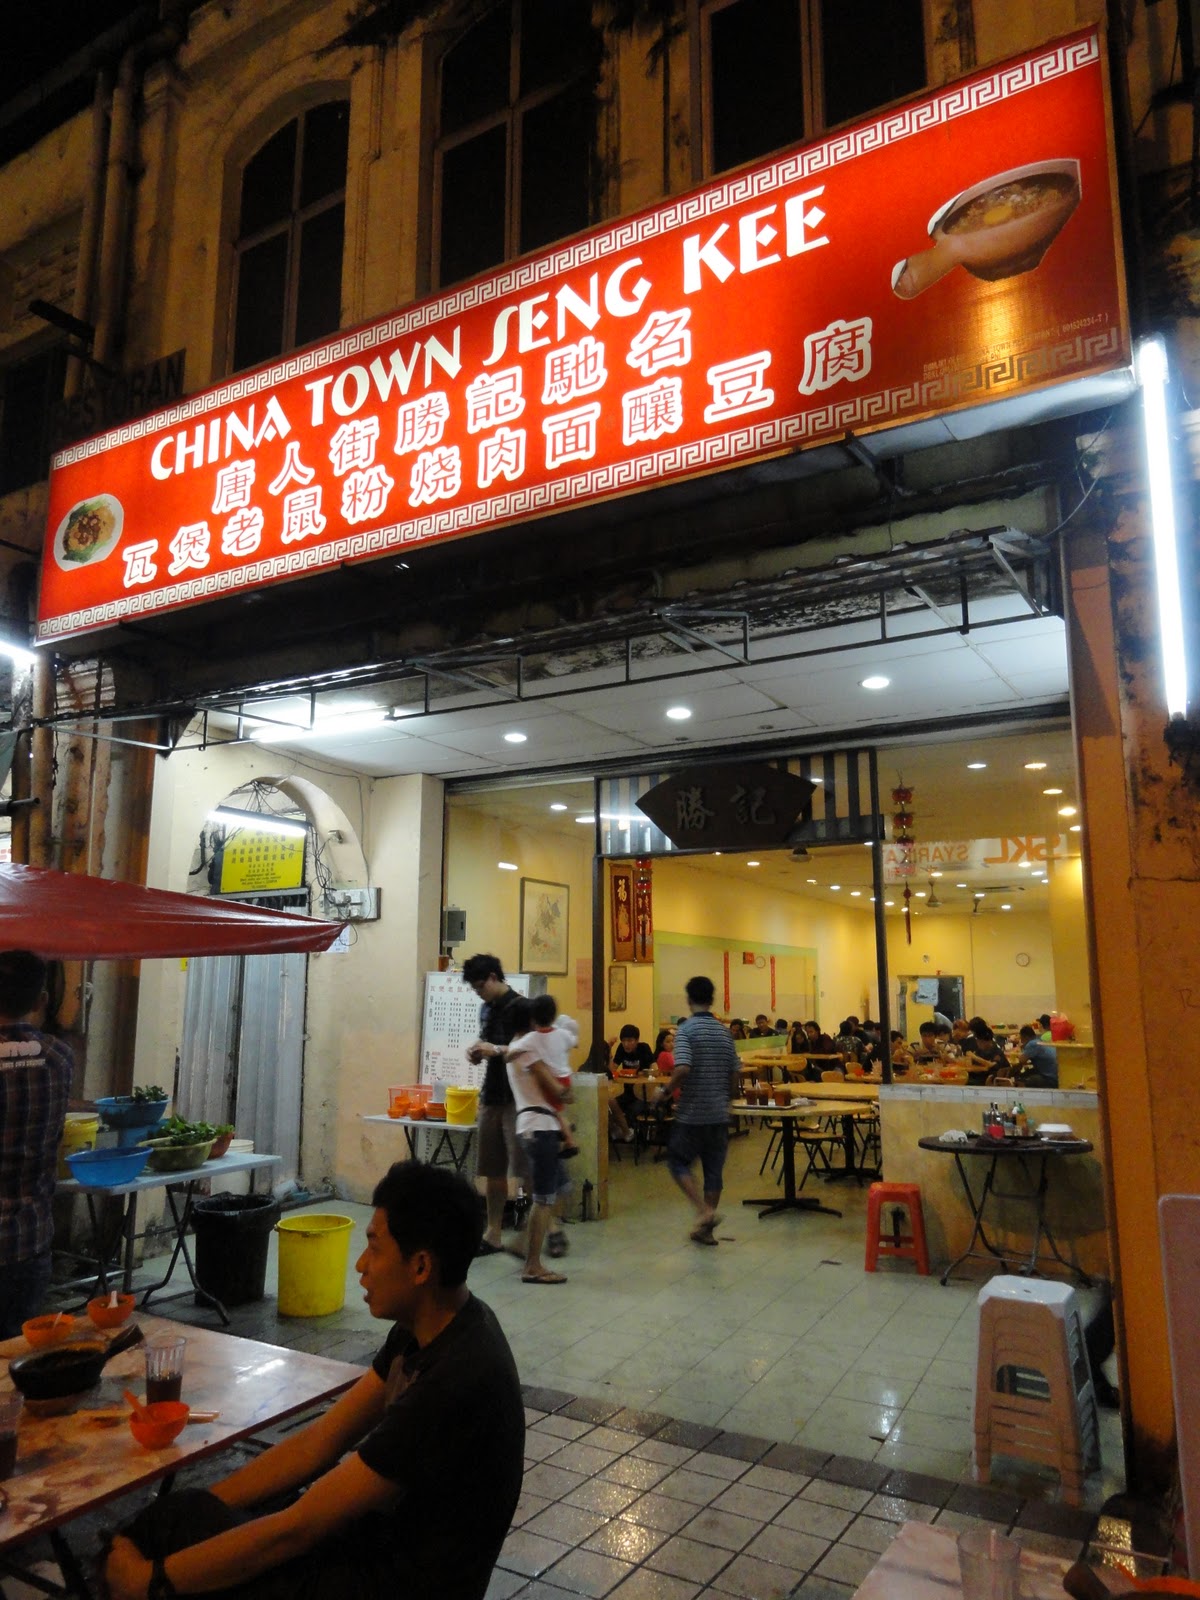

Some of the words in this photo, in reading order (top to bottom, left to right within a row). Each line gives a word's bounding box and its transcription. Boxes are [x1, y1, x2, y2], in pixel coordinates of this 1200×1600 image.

[151, 395, 291, 480] CHINA
[304, 325, 462, 427] TOWN
[482, 257, 653, 367] SENG
[683, 185, 830, 295] KEE
[211, 298, 692, 515] 唐人街勝記馳名
[677, 785, 776, 830] 勝記
